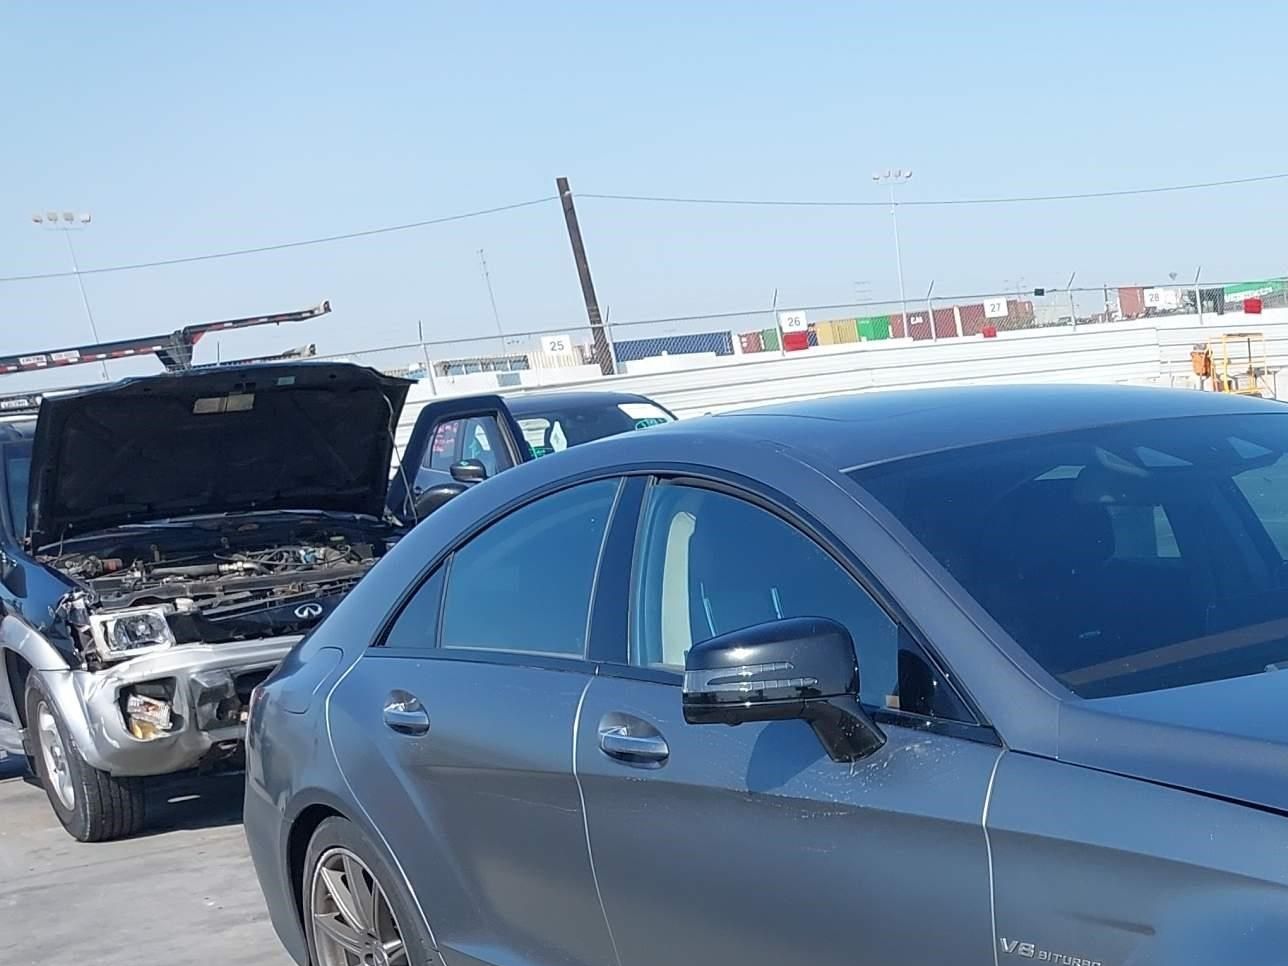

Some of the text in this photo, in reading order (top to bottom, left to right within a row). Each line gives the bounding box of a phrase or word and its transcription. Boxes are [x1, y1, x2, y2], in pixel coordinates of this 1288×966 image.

[1150, 293, 1160, 302] 28
[990, 303, 1002, 313] 27
[787, 316, 800, 327] 26
[549, 341, 565, 352] 25
